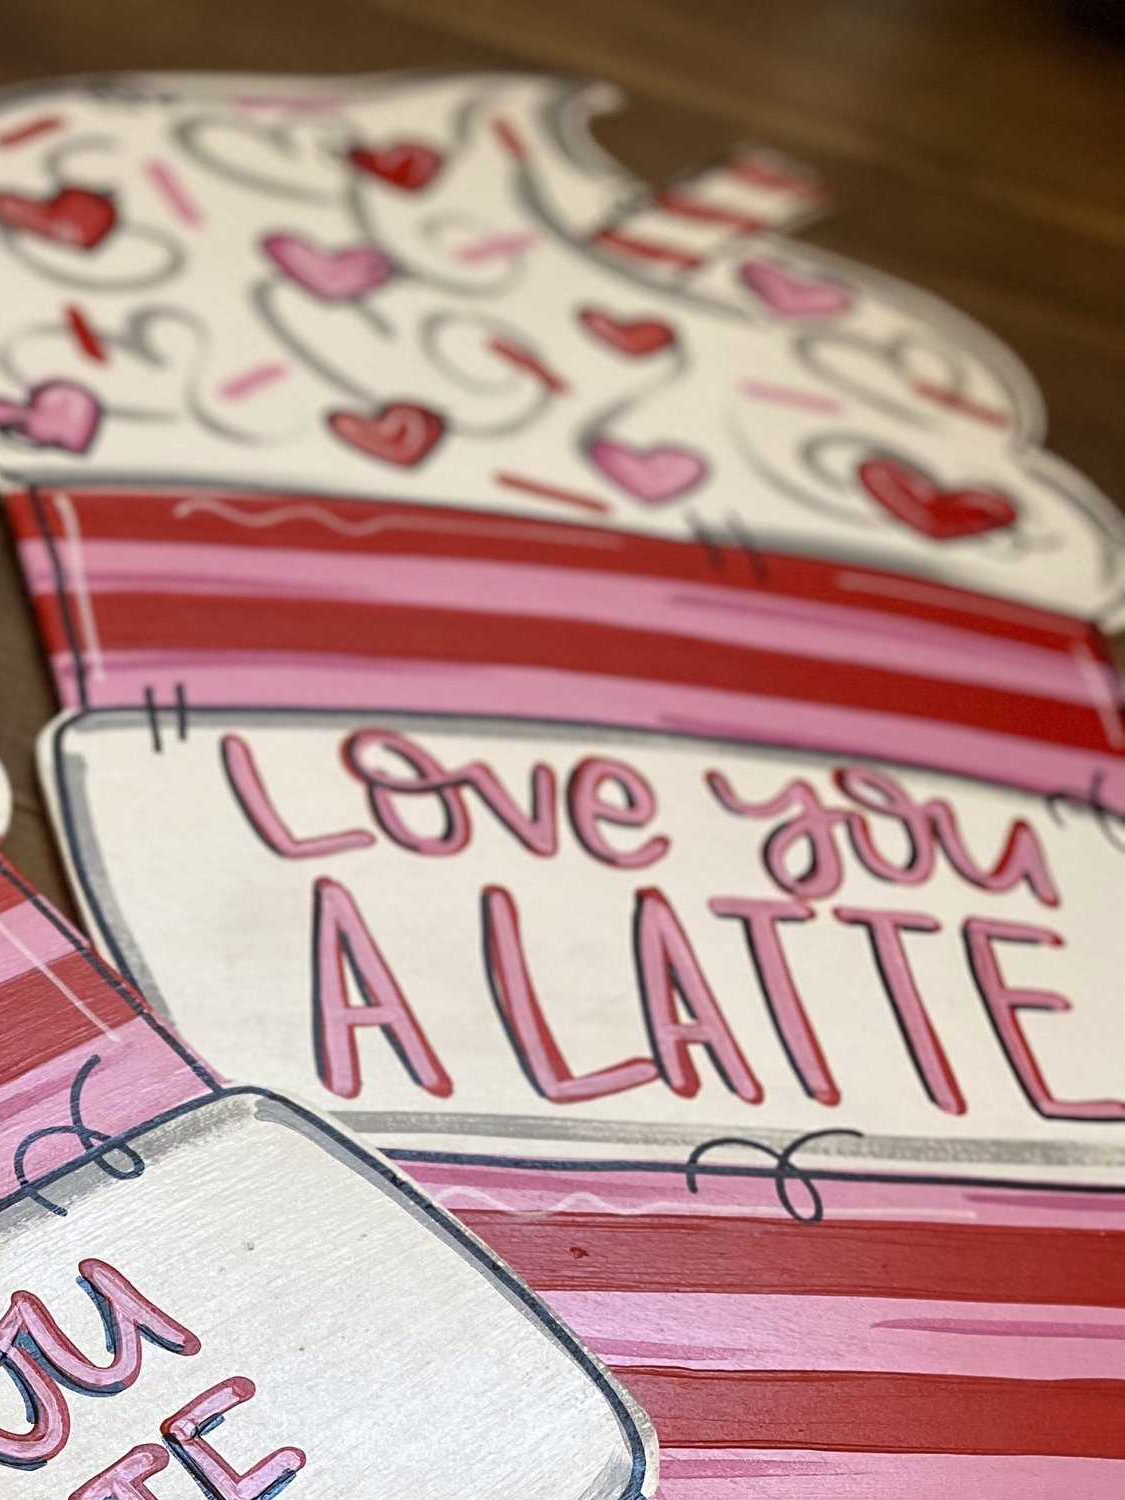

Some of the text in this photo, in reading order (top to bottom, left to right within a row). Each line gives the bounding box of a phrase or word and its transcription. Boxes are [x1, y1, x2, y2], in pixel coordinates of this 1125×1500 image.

[221, 728, 1059, 907] Love you
[311, 877, 1125, 1120] A LATTE
